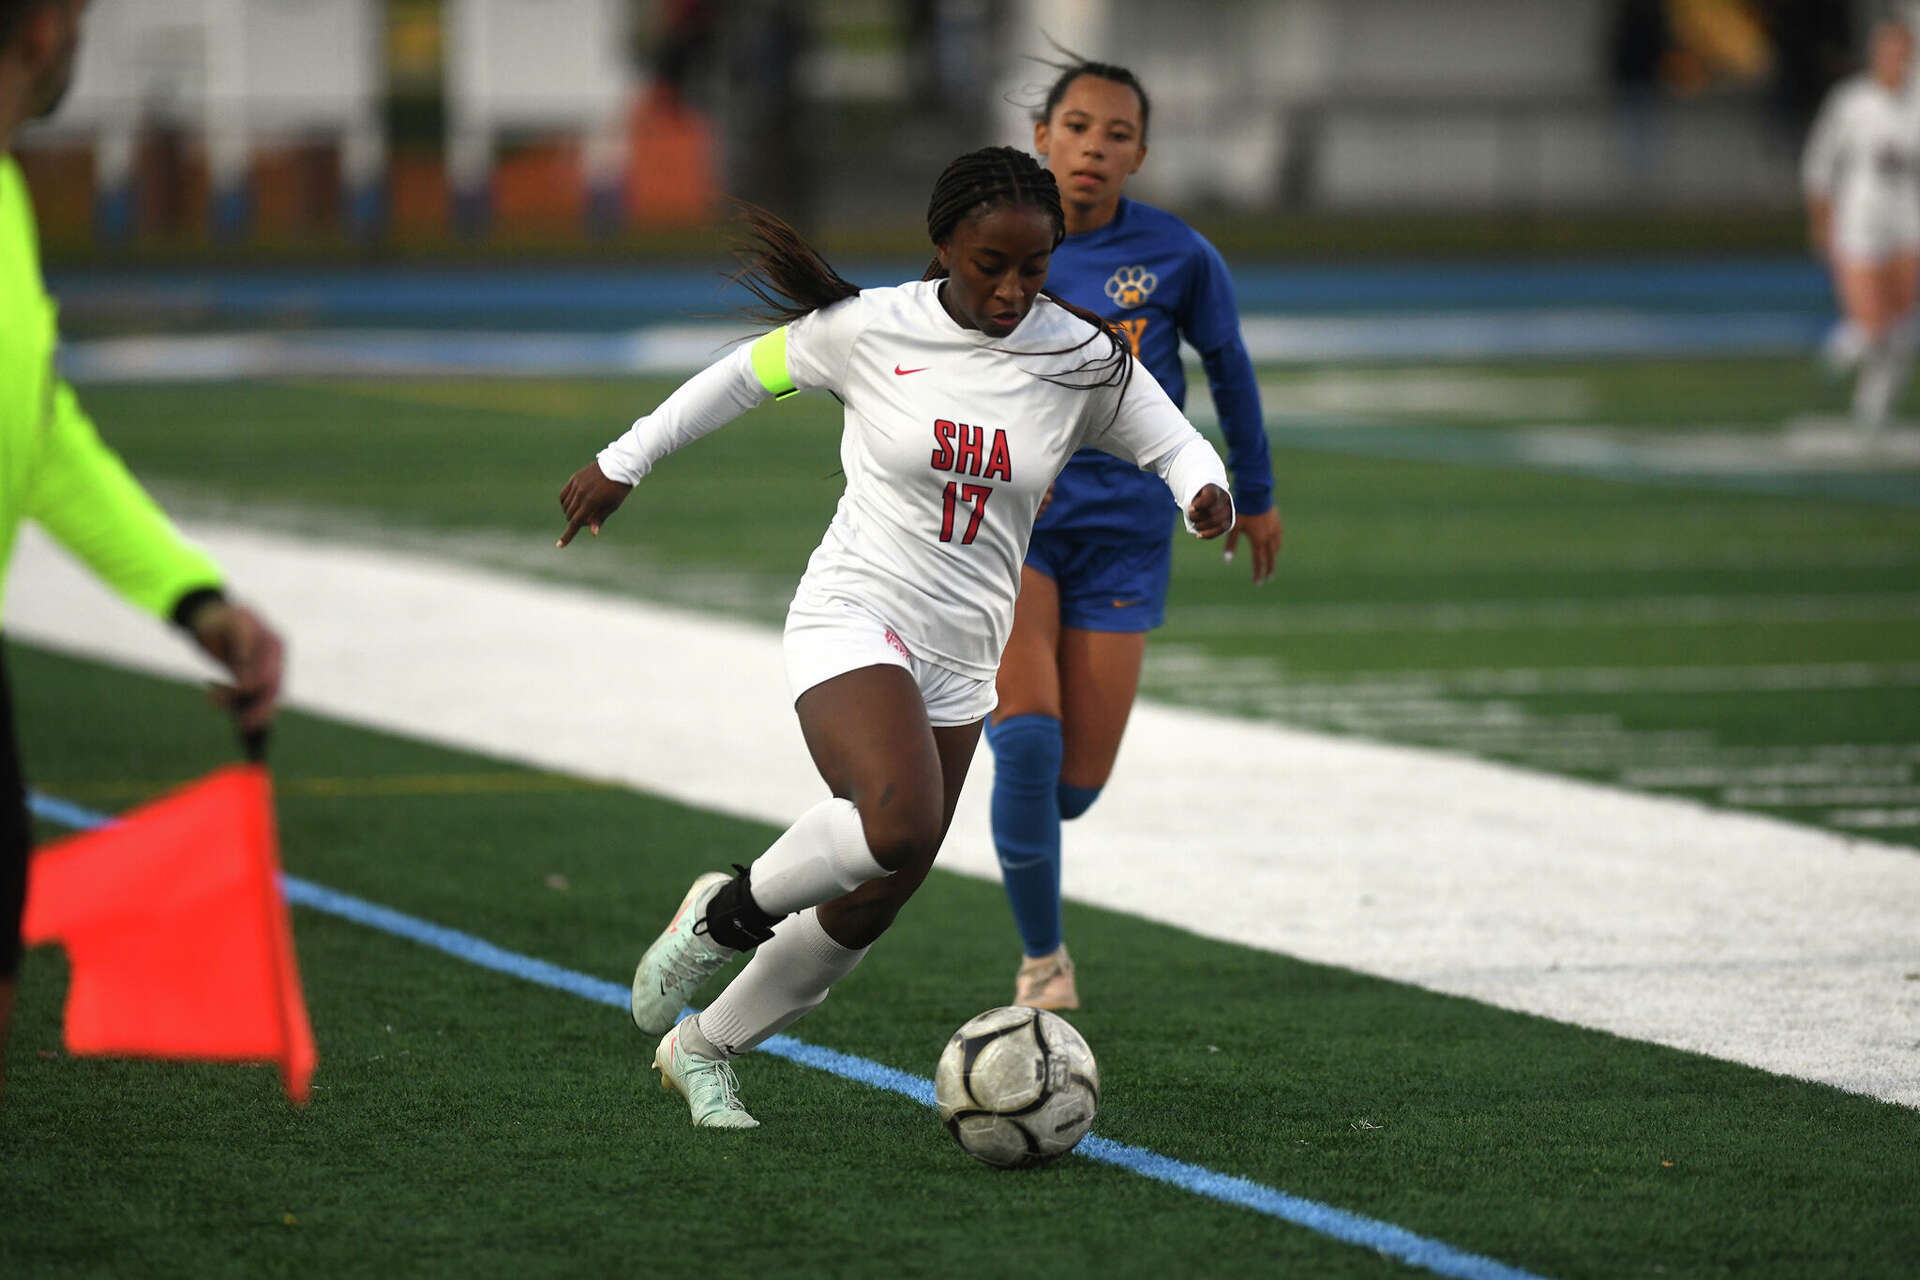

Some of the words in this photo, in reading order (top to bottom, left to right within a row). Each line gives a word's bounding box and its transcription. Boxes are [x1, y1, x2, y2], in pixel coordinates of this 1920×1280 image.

[1108, 317, 1148, 361] Y
[931, 419, 1011, 483] SHA
[939, 481, 993, 545] 17
